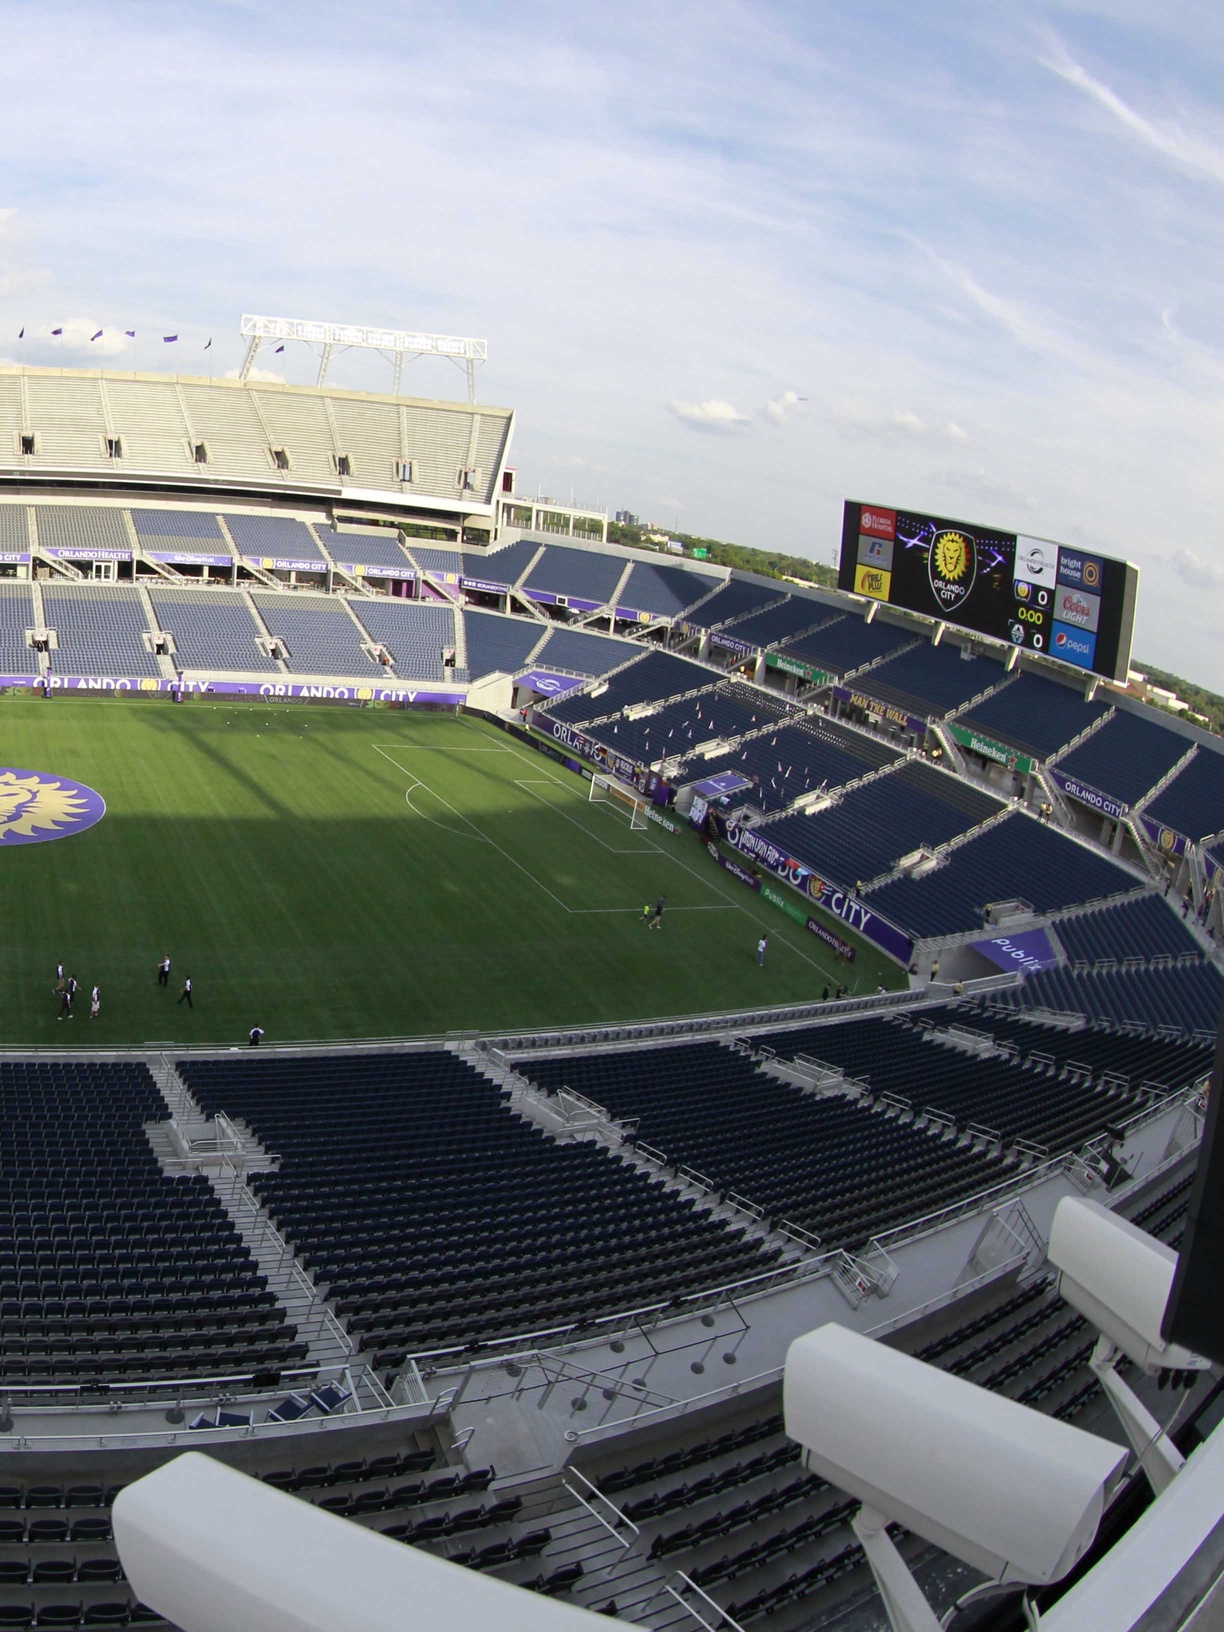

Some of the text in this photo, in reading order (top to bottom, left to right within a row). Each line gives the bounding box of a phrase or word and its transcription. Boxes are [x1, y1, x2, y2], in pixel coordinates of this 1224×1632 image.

[57, 549, 130, 559] ORLANDO HEALTH
[1060, 555, 1082, 569] bright
[276, 560, 327, 571] ORLANDO CITY
[368, 568, 415, 578] ORLANDO CITY
[1059, 565, 1081, 578] house
[933, 579, 965, 595] ORLANDO
[940, 589, 956, 601] CITY
[1037, 590, 1048, 605] 0
[1063, 595, 1091, 616] Coors
[1018, 607, 1043, 625] 0:00
[1062, 610, 1088, 625] LIGHT
[711, 634, 747, 653] ORLANDO CITY
[1033, 633, 1043, 648] 0
[1066, 639, 1089, 653] pepsi
[776, 657, 805, 677] Heineken
[33, 676, 210, 693] ORLANDO CITY
[260, 683, 418, 703] ORLANDO CITY
[850, 693, 908, 726] MAN THE WALL
[970, 737, 1007, 763] Heineken
[1064, 780, 1122, 817] ORLANDO CITY
[644, 804, 675, 833] Heineken
[764, 888, 785, 908] Publix
[831, 892, 872, 931] CITY
[808, 920, 833, 944] ORLANDO
